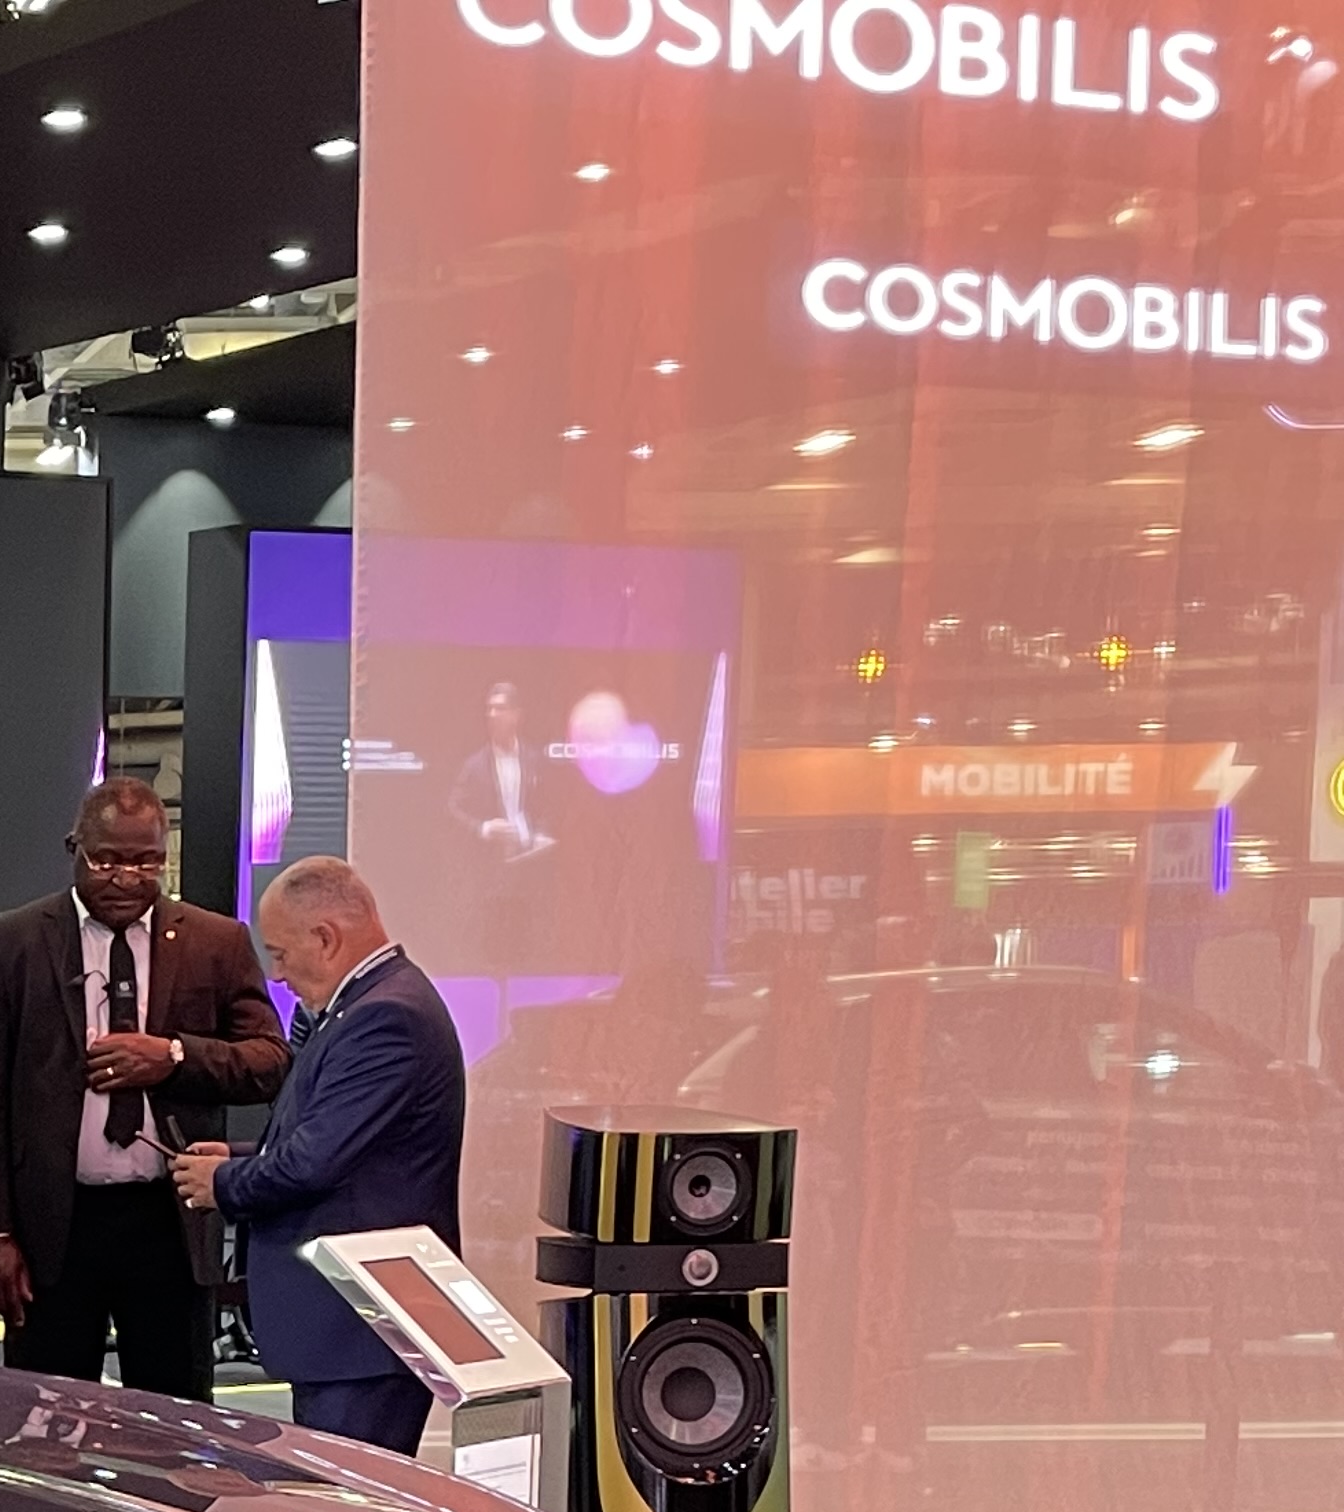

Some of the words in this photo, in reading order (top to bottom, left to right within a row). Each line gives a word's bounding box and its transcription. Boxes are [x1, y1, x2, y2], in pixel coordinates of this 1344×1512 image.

[802, 258, 1328, 363] COSMOBILIS
[920, 756, 1134, 797] MOBILITÉ
[730, 868, 868, 901] telier
